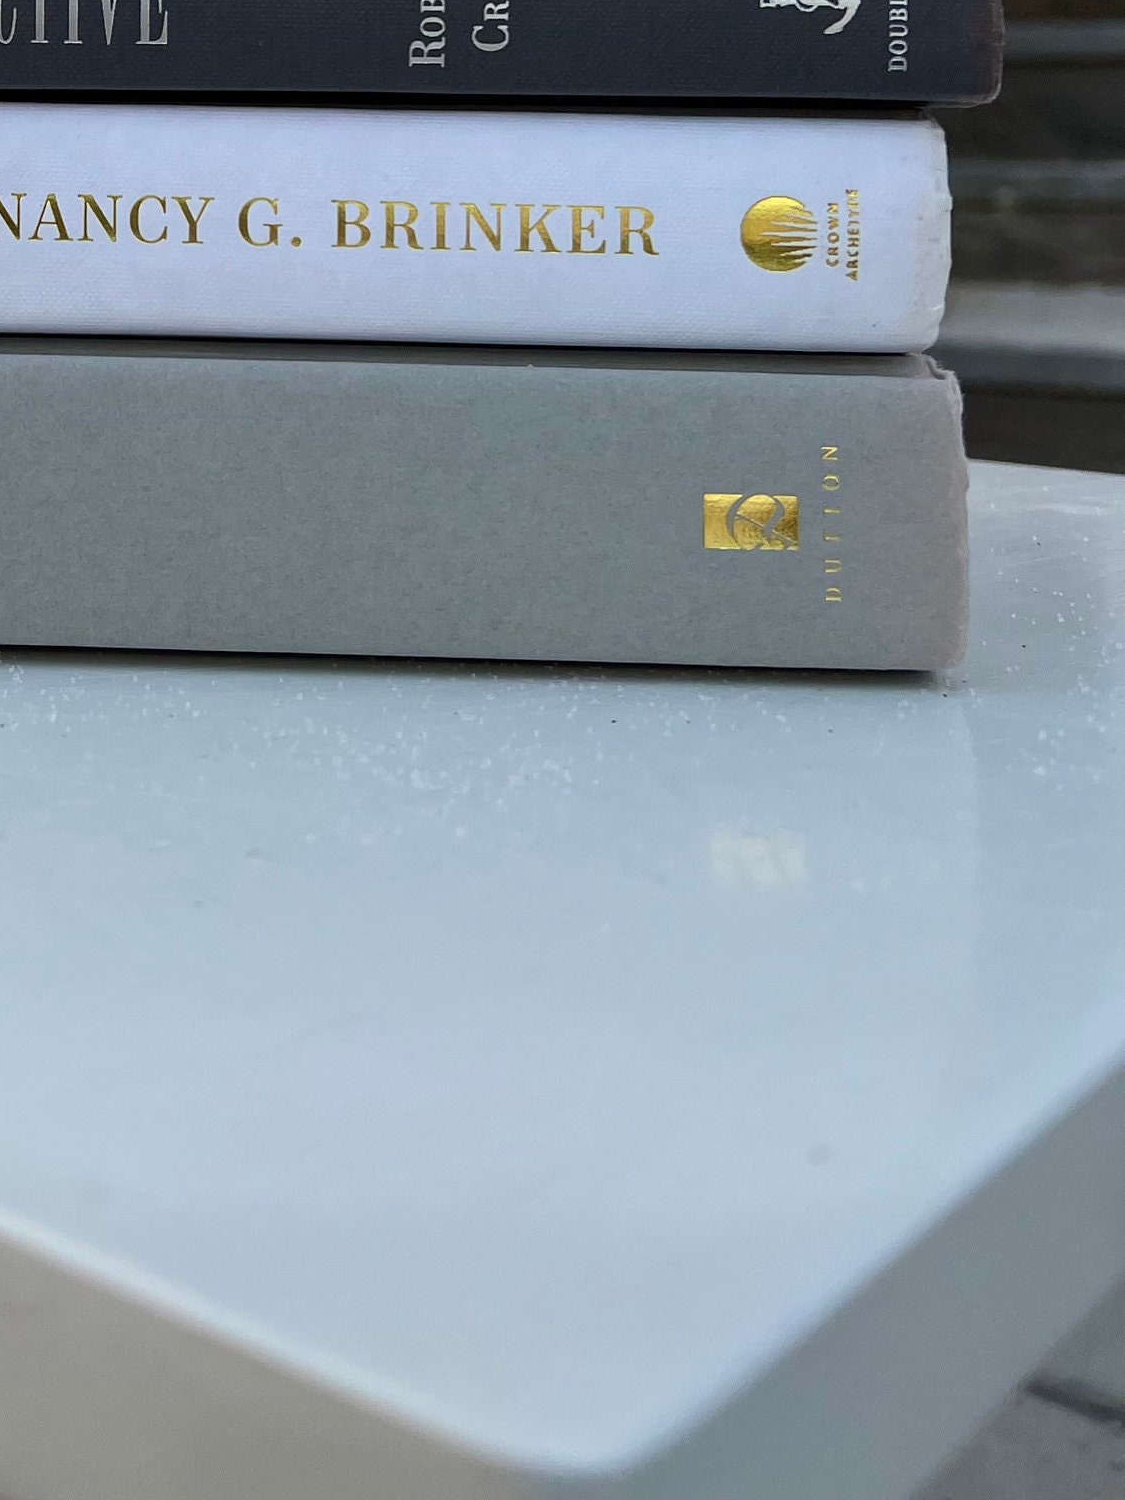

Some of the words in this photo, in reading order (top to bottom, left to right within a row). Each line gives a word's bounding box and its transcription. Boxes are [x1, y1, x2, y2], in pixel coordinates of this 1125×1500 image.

[237, 197, 302, 247] G.
[331, 200, 659, 255] BRINKER
[827, 203, 839, 267] CROWN
[846, 189, 859, 281] ARCHETYPE
